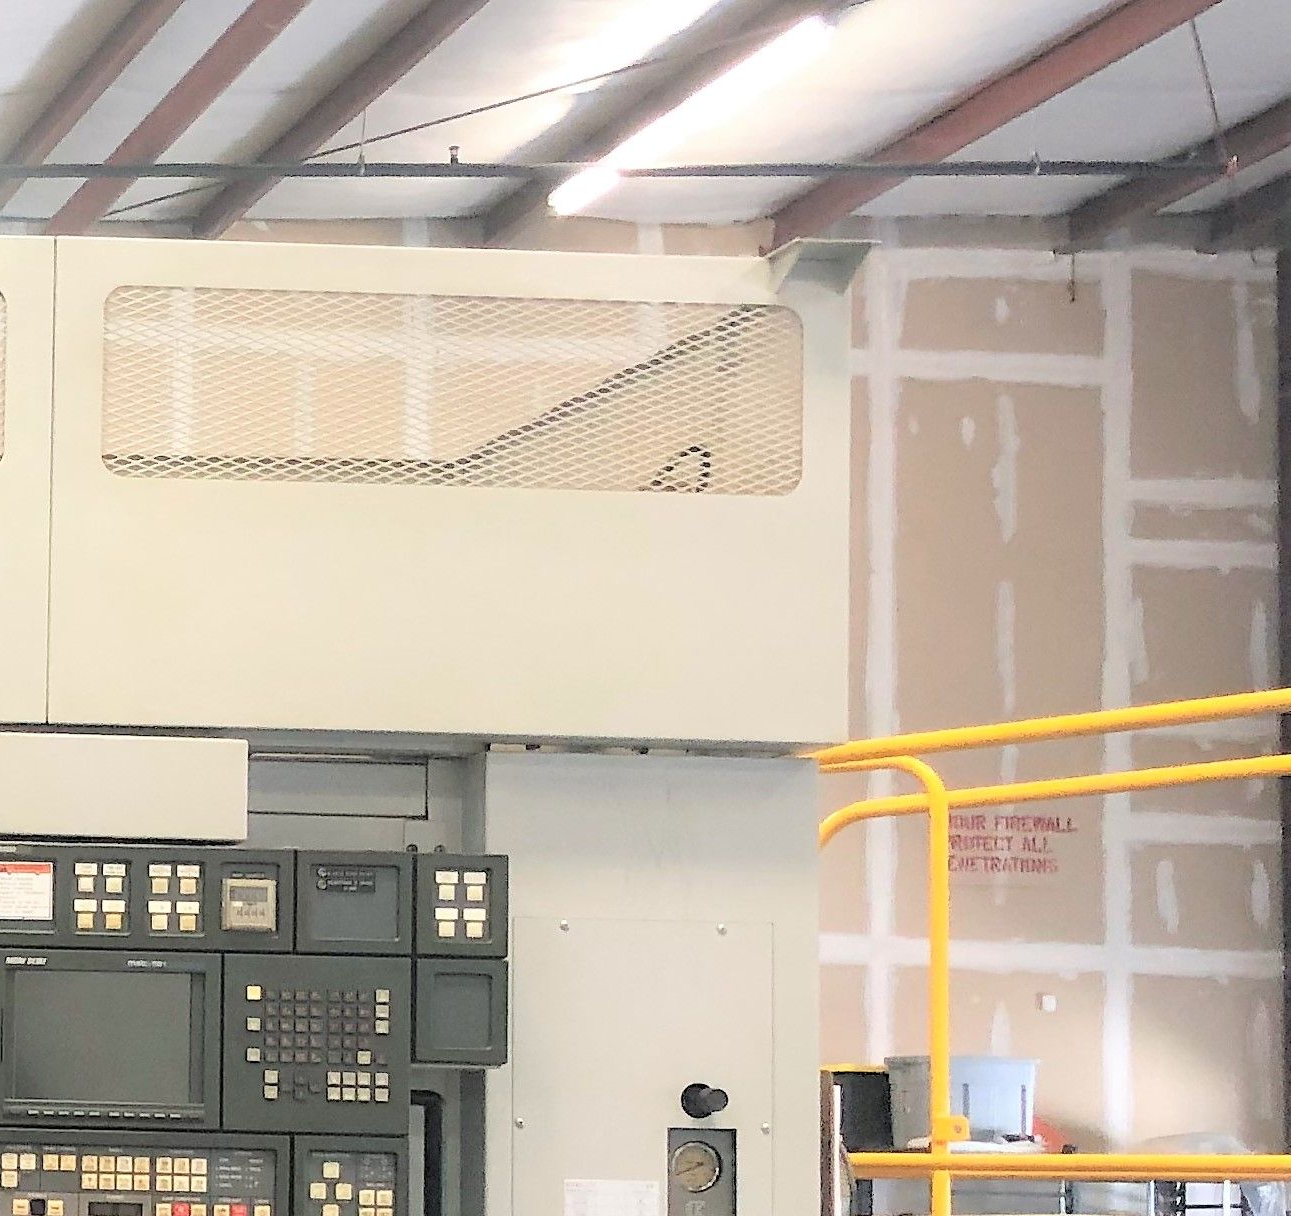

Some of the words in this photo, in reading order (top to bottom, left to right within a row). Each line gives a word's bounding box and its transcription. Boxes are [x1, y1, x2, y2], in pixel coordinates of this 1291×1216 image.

[994, 815, 1078, 833] FIREWALL
[949, 834, 1013, 851] ROTECT
[1021, 836, 1053, 853] ALL
[948, 855, 1059, 873] ENETRATIONS
